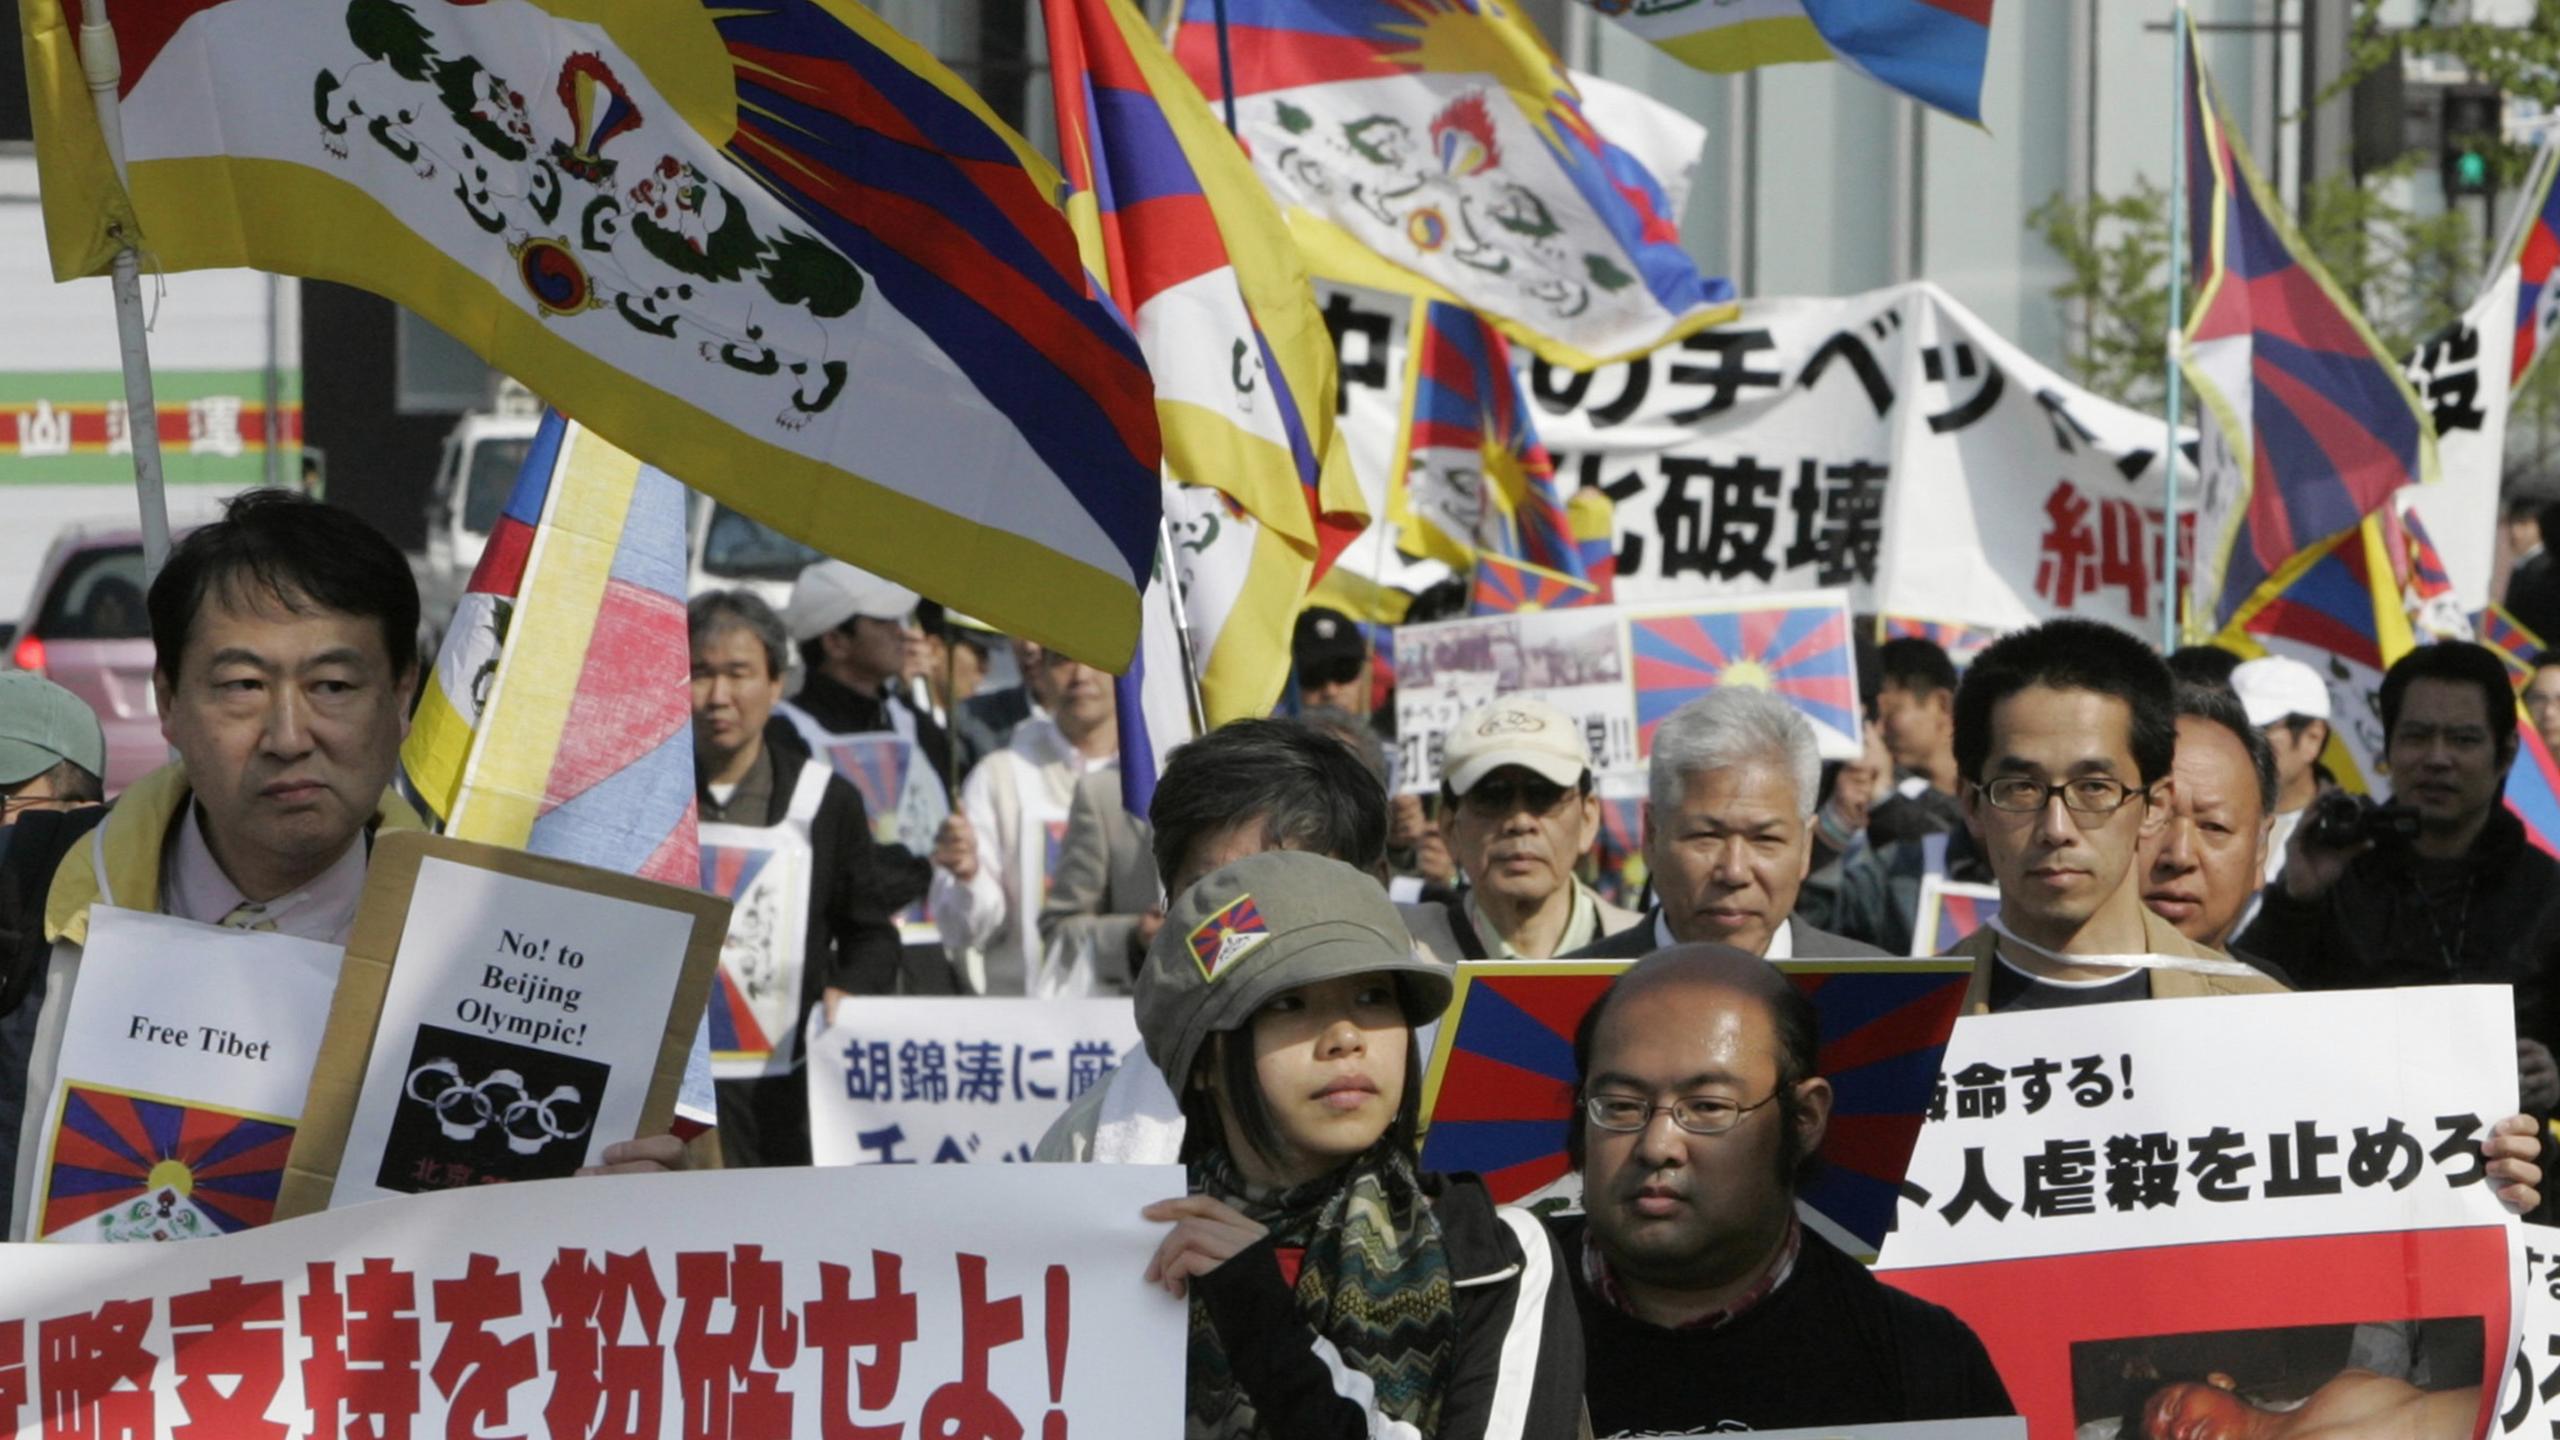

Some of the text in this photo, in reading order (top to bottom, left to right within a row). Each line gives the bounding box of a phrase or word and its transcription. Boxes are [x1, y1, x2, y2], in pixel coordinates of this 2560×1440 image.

[498, 929, 584, 969] No! to
[480, 964, 582, 1013] Beijing
[128, 1014, 271, 1062] Free Tibet
[456, 998, 587, 1047] Olympic!
